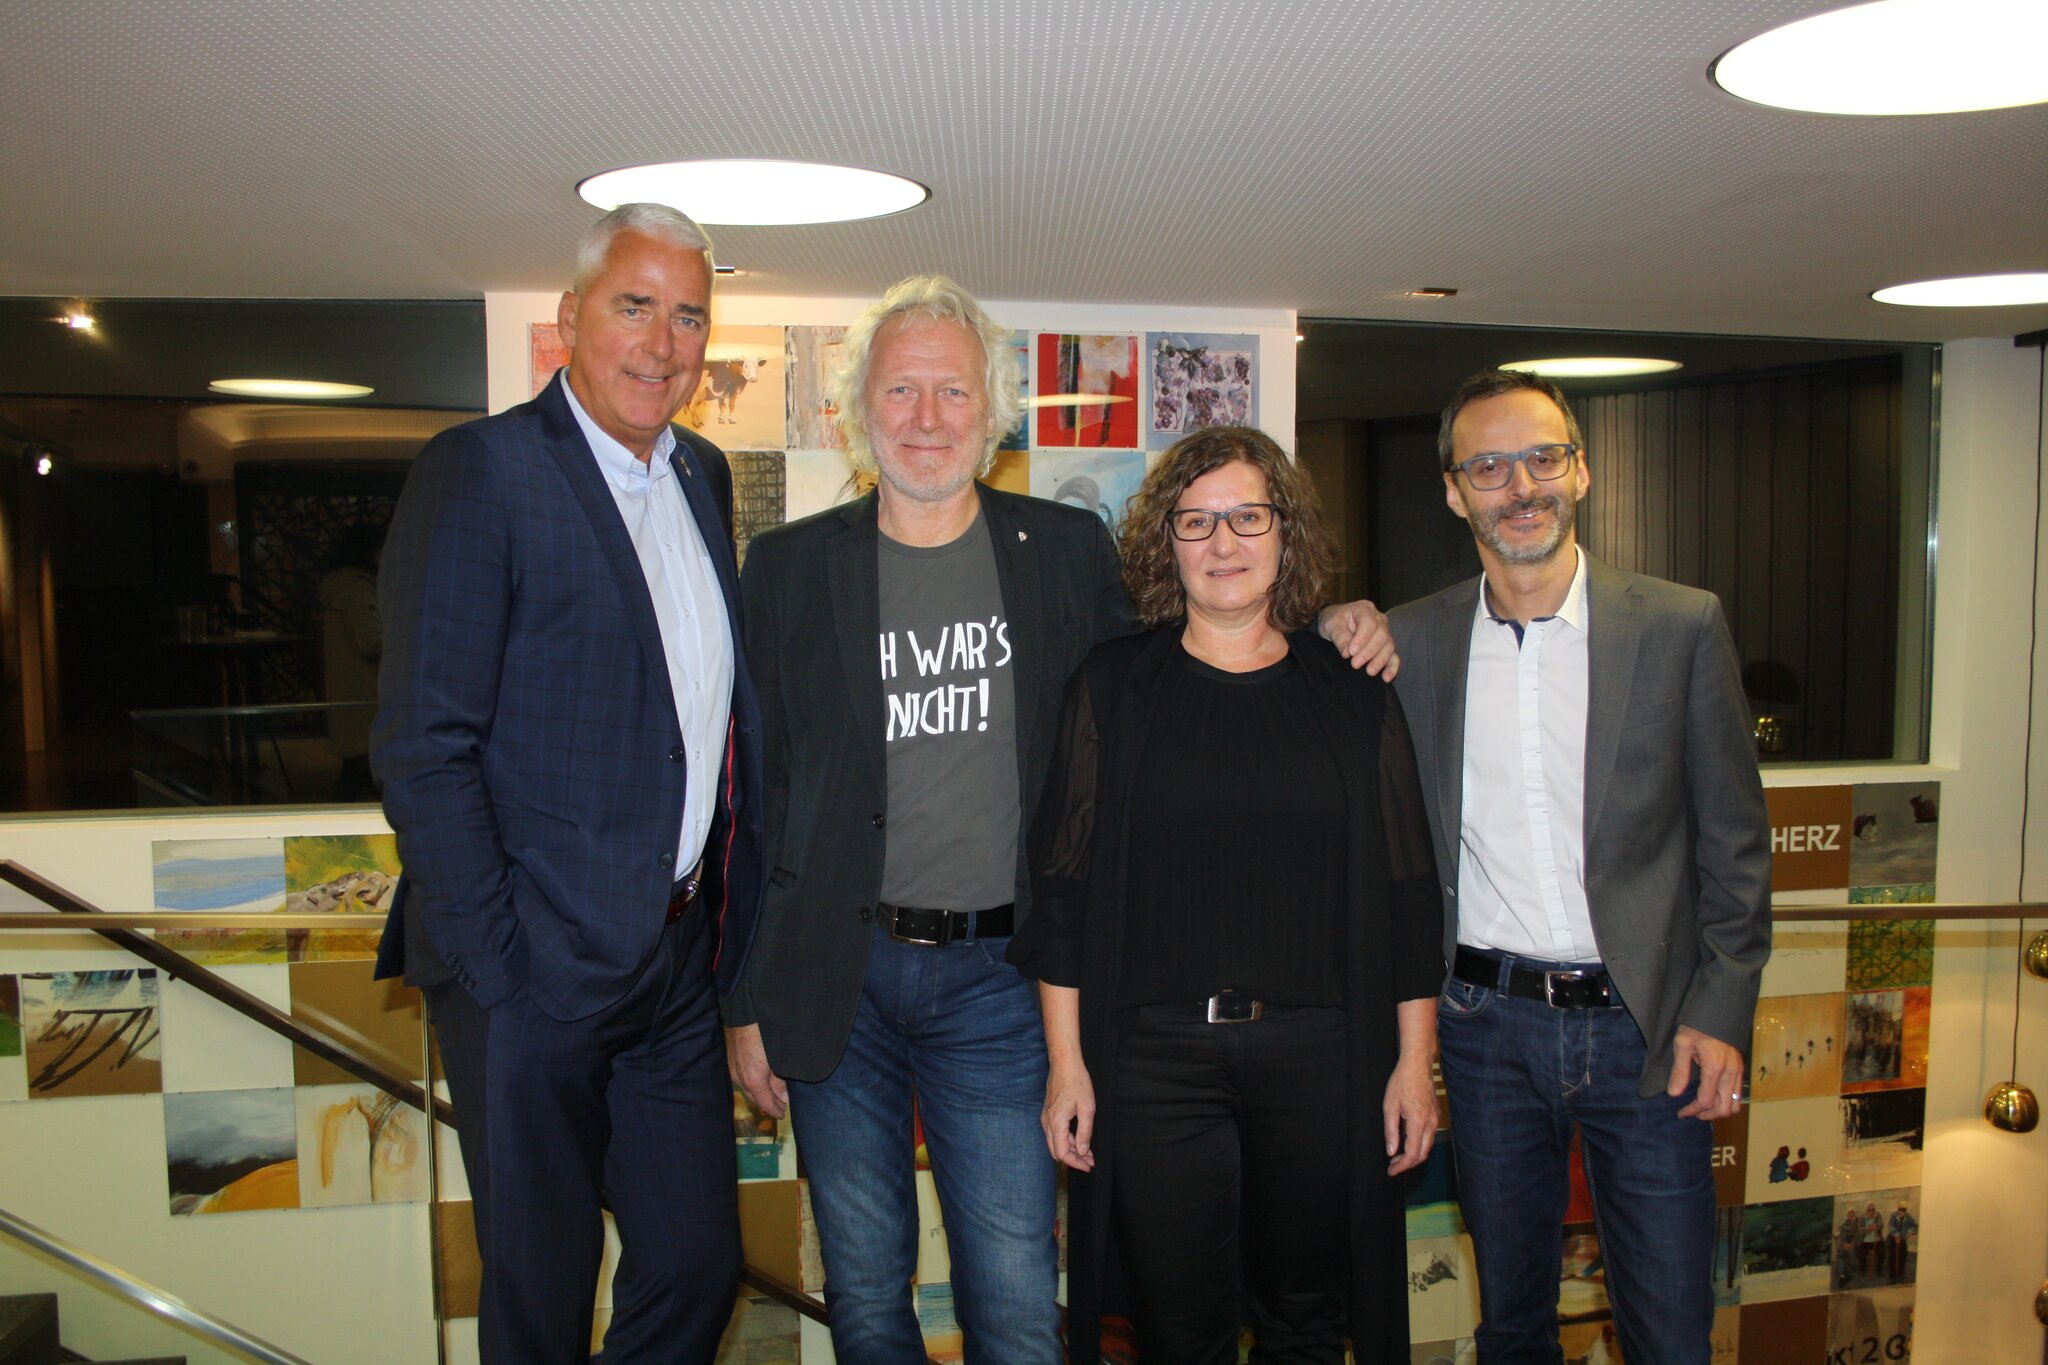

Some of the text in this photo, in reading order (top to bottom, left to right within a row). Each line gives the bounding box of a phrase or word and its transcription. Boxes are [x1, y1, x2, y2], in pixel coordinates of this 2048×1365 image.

[907, 615, 1012, 677] WAR'S
[886, 678, 990, 742] NICHT!
[1770, 824, 1841, 853] HERZ
